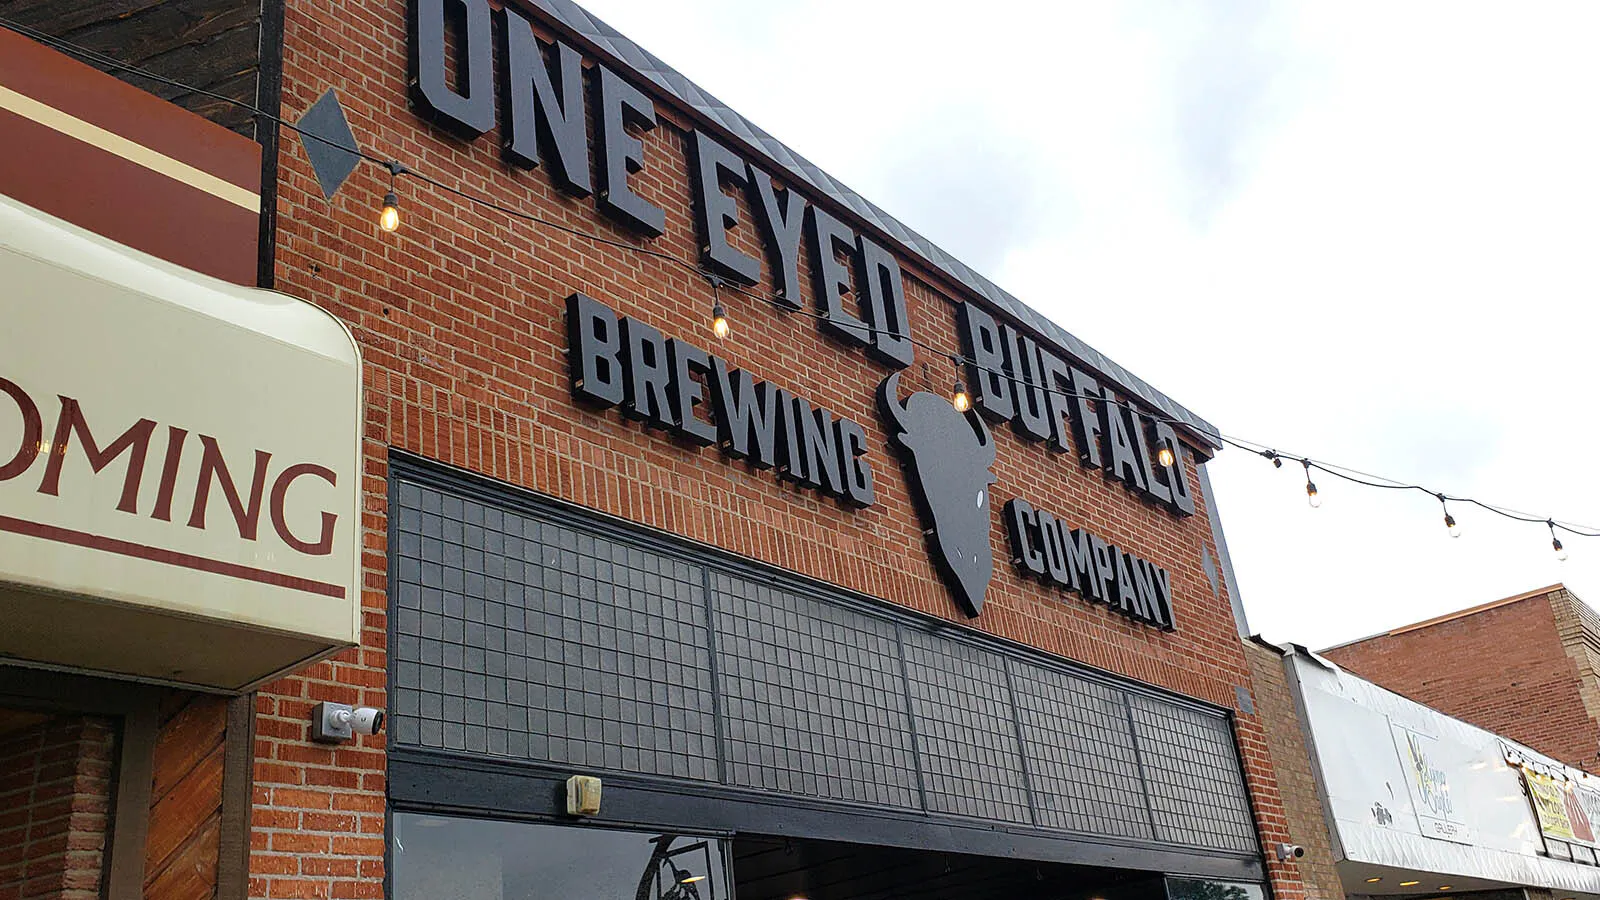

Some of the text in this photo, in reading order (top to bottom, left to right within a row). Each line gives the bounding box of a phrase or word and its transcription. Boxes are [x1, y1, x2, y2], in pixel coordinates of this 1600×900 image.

[411, 0, 1195, 517] ONE EYED BUFFALO
[566, 293, 1177, 633] BREWING COMPANY
